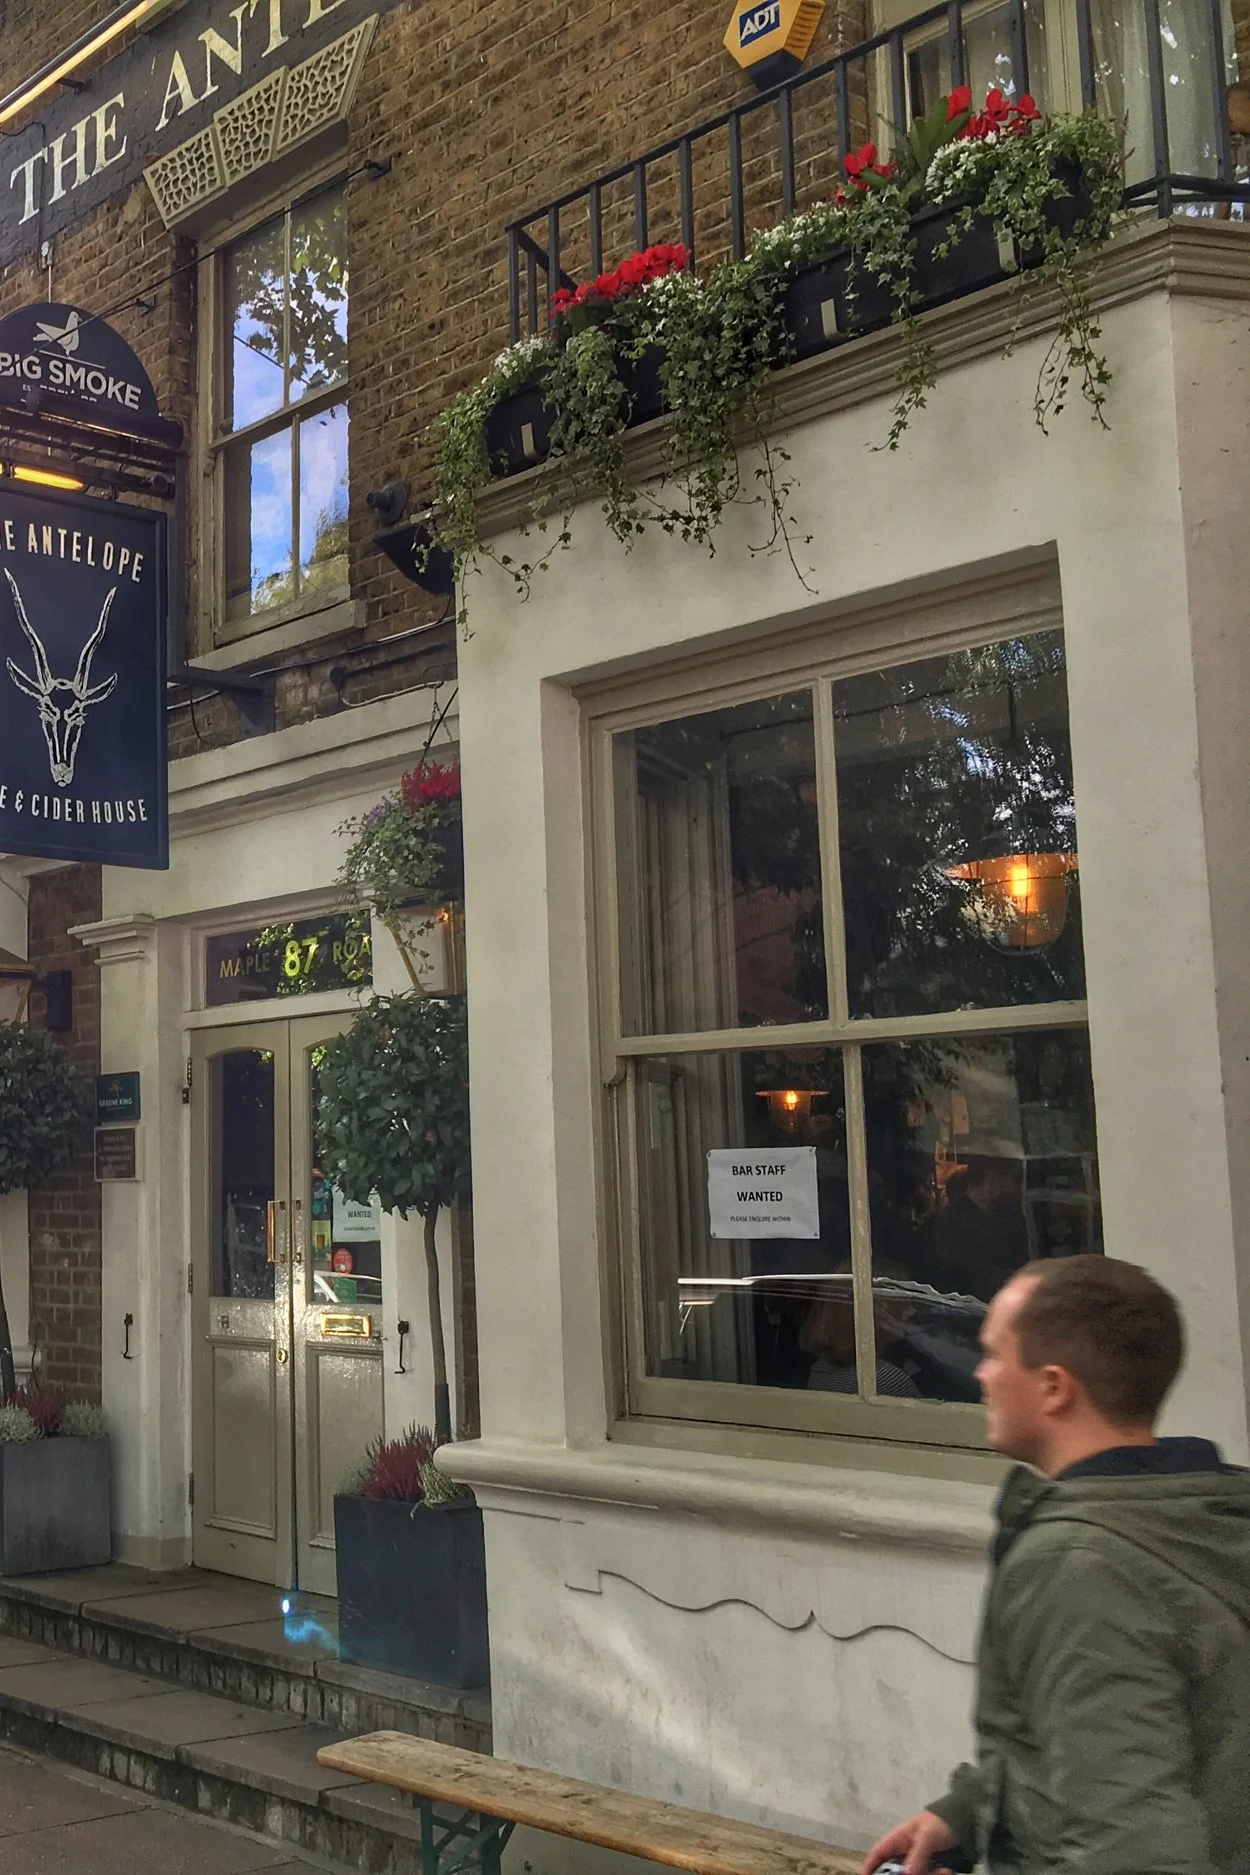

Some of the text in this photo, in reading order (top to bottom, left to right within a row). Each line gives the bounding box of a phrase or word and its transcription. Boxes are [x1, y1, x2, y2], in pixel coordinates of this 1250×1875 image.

[740, 4, 777, 40] ADT
[10, 91, 127, 226] THE
[49, 361, 142, 410] SMOKE
[28, 523, 144, 583] ANTELOPE
[14, 790, 24, 812] &
[31, 794, 85, 823] CIDER
[91, 799, 148, 824] HOUSE
[219, 935, 371, 979] MAPLE 87 ROA
[732, 1165, 786, 1176] BAR STAFF
[347, 1210, 372, 1219] WANTED
[736, 1191, 783, 1202] WANTED
